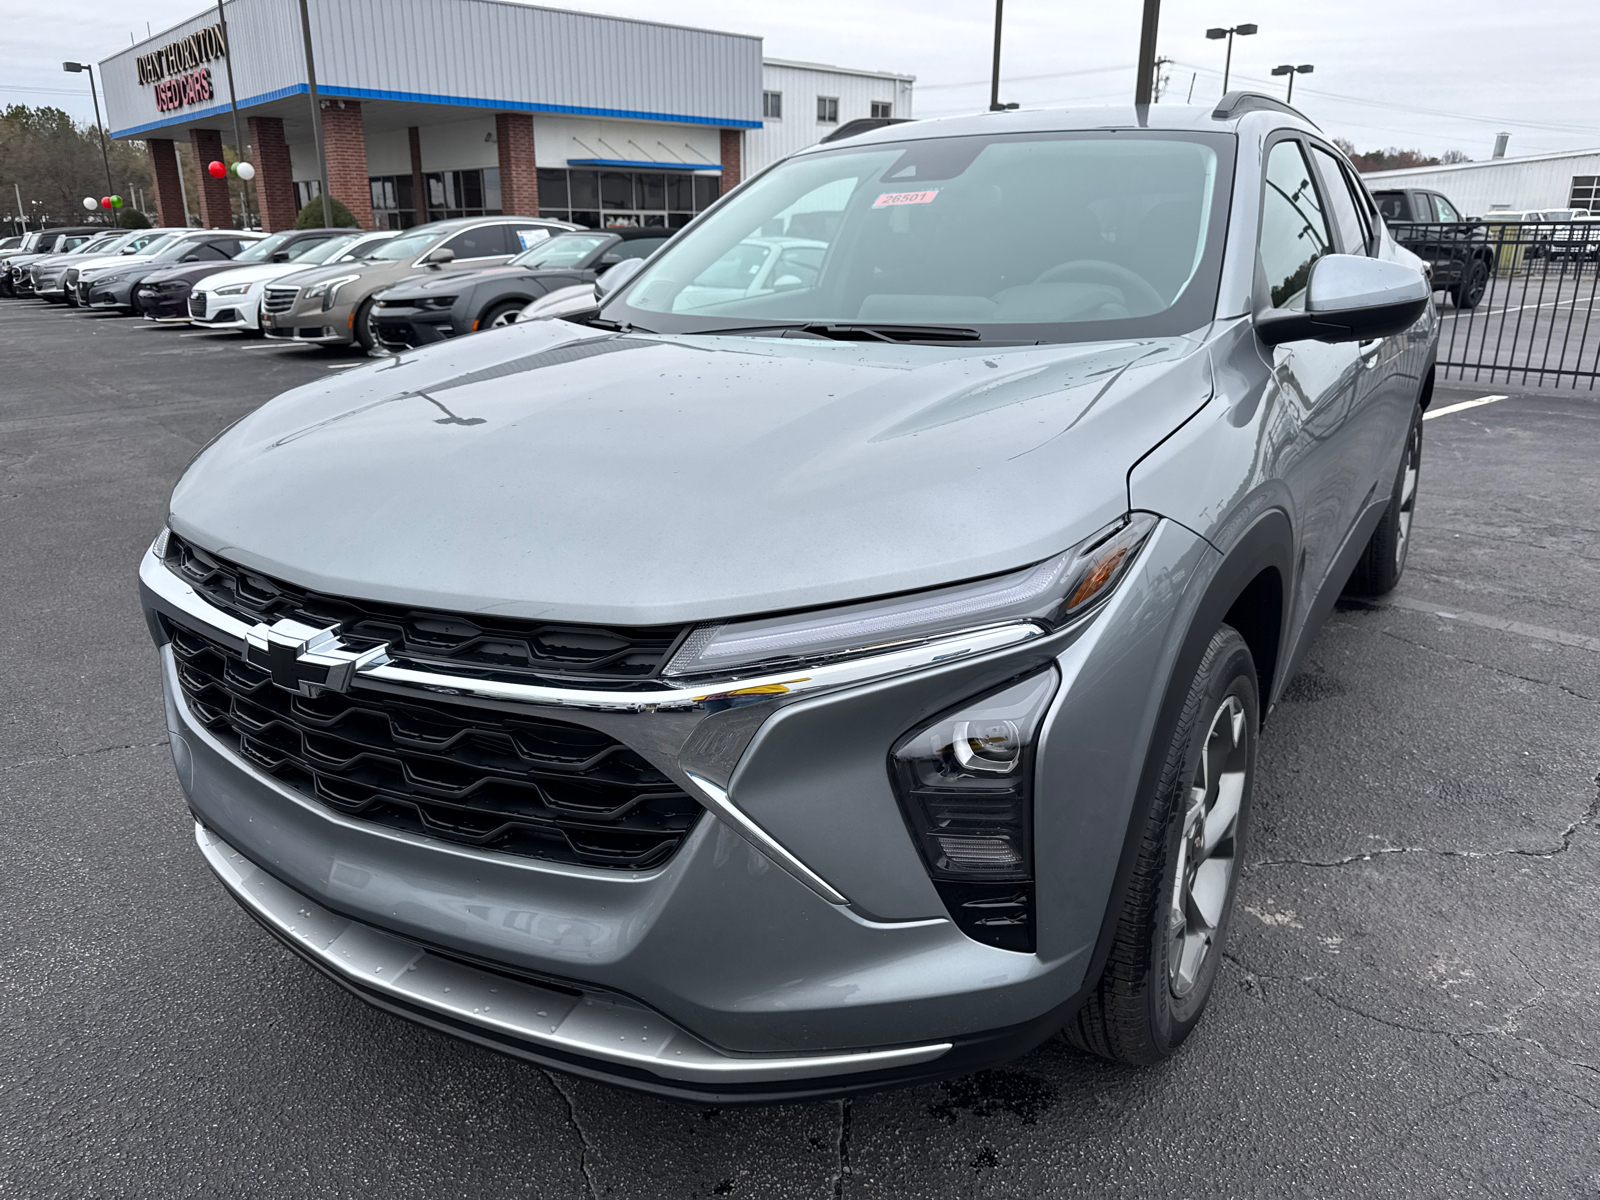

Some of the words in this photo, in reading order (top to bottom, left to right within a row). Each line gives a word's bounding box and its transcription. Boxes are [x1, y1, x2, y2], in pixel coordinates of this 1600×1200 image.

[136, 51, 164, 85] JOHN
[160, 22, 226, 75] THORNTON
[153, 79, 182, 112] USED
[180, 68, 213, 105] CARS
[882, 193, 927, 204] 26501
[1160, 914, 1169, 1014] Dynapro
